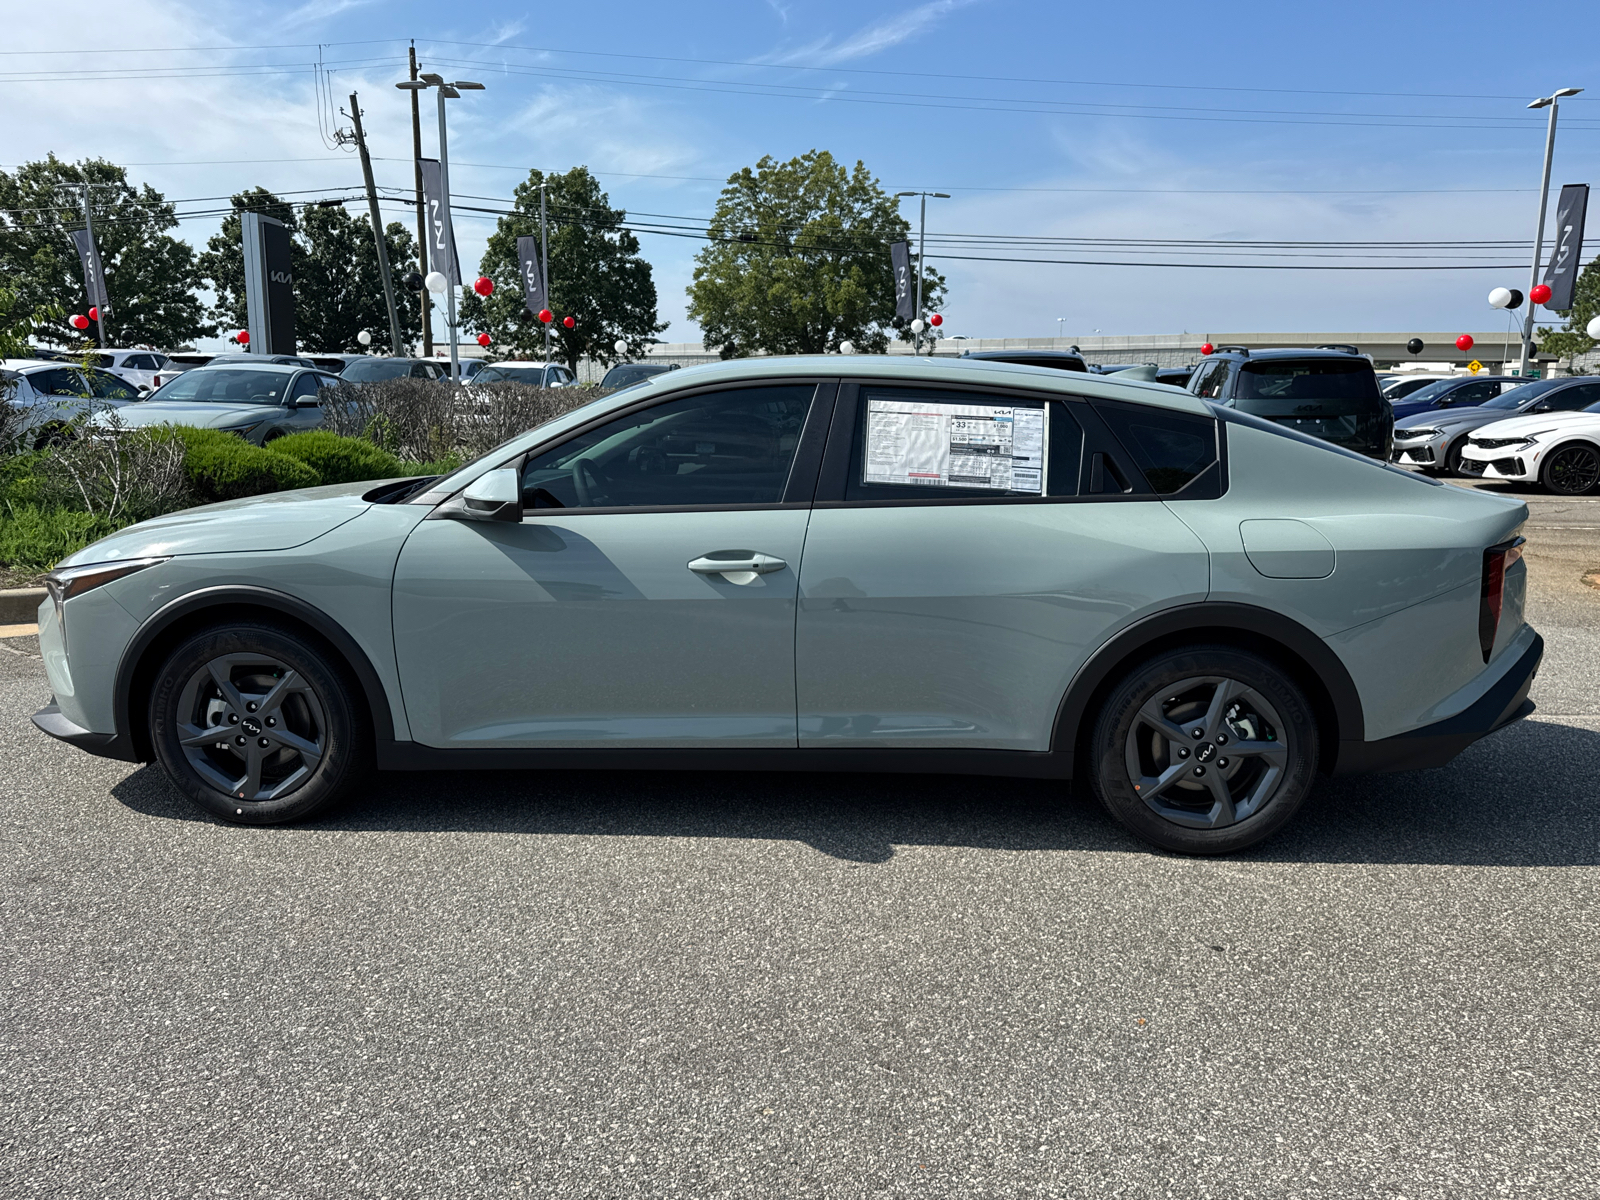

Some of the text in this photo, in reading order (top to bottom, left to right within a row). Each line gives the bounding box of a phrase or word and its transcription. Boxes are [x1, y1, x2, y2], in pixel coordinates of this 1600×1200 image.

[270, 270, 292, 284] KIA
[155, 675, 174, 735] KUMHO
[1257, 671, 1304, 724] KUMHO
[243, 720, 260, 734] KIA
[1198, 744, 1214, 761] KIA
